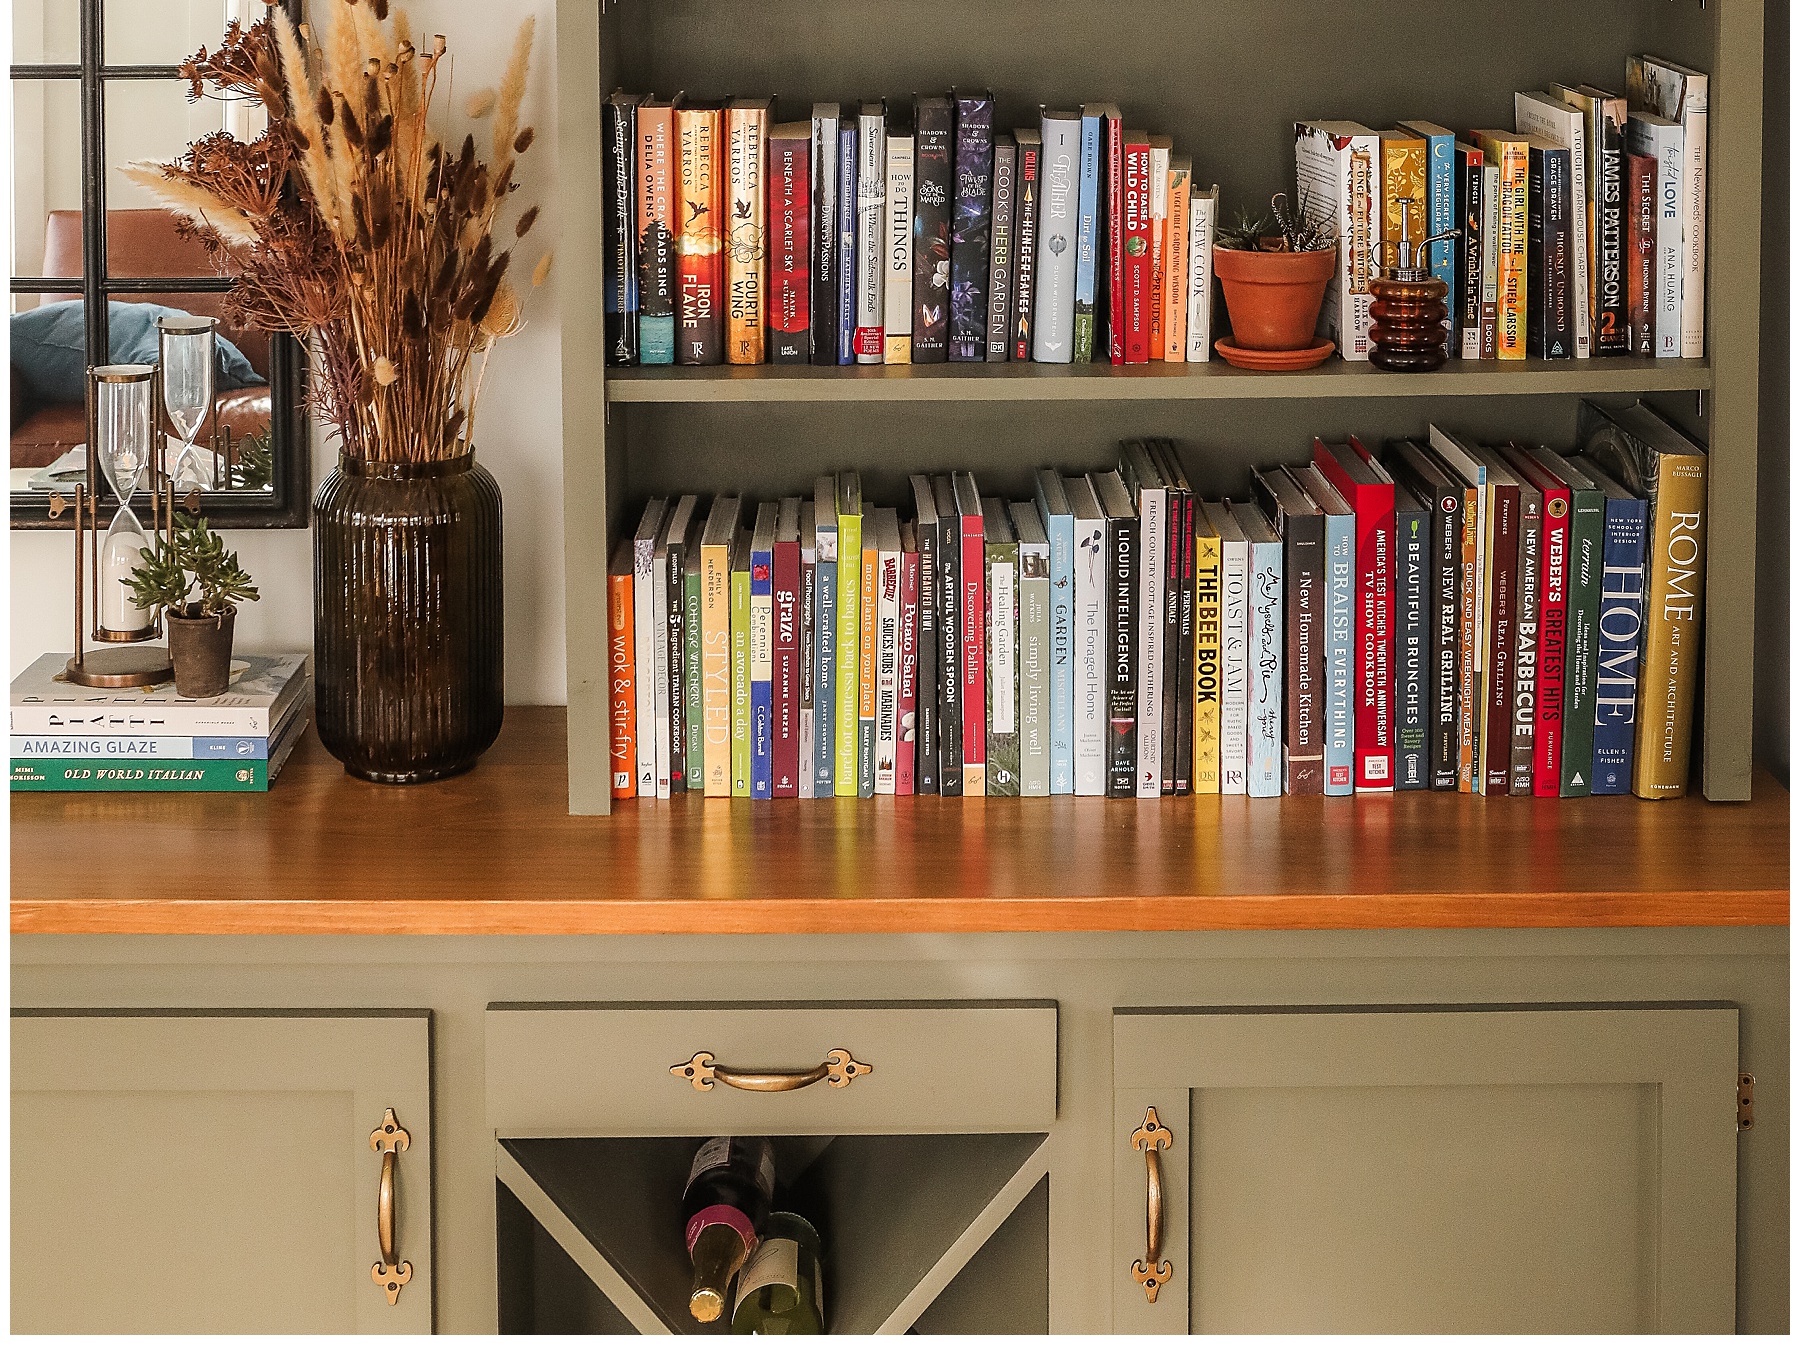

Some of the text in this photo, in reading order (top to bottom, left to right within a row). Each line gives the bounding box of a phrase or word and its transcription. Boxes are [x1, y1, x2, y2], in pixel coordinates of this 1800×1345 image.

[682, 131, 693, 186] YARROS
[700, 125, 709, 191] REBECCA
[784, 151, 793, 195] BENEATH
[1127, 152, 1137, 231] WILD CHILD
[1140, 152, 1148, 231] HOW TO RAISE A
[656, 123, 667, 296] WHERE THE CRAWDADS SING
[784, 210, 793, 252] SCARLET
[893, 195, 907, 271] THINGS
[1502, 181, 1512, 254] DRAGON TATTOO
[1514, 167, 1525, 255] THE GIRL WITH THE
[1602, 148, 1621, 307] JAMES PATTERSON
[1664, 182, 1676, 218] LOVE
[784, 254, 793, 273] SKY
[992, 166, 1010, 334] COOK'S HERB GARDEN
[682, 275, 696, 328] FLAME
[698, 284, 710, 318] IRON
[732, 281, 744, 319] WING
[746, 272, 758, 327] FOURTH
[1506, 278, 1518, 348] STIEG LARSSON
[1580, 538, 1594, 587] terrain
[776, 591, 796, 642] graze
[965, 582, 978, 684] Discovering Dahlias
[1116, 529, 1130, 682] LIQUID INTELLIGENCE
[1197, 565, 1218, 704] THE BEE BOOK
[1406, 543, 1419, 725] BEAUTIFUL BRUNCHES
[1440, 515, 1454, 725] WEBER'S NEW REAL GRILLING.
[1515, 529, 1536, 736] NEW AMERICAN BARBECUE
[1543, 528, 1563, 721] WEBER'S GREATEST HITS
[1595, 561, 1647, 726] HOME
[1663, 510, 1701, 763] ROME ART AND ARCHITECTURE
[705, 631, 728, 744] STYLED
[902, 602, 916, 699] Potato Salad
[1299, 578, 1313, 745] New Homemade Kitchen
[1333, 562, 1349, 749] BRAISE EVERYTHING
[609, 635, 632, 760] wok & stir-fry
[1026, 636, 1041, 756] simply living well
[23, 741, 158, 754] AMAZING GLAZE
[64, 769, 205, 780] OLD WORLD ITALIAN
